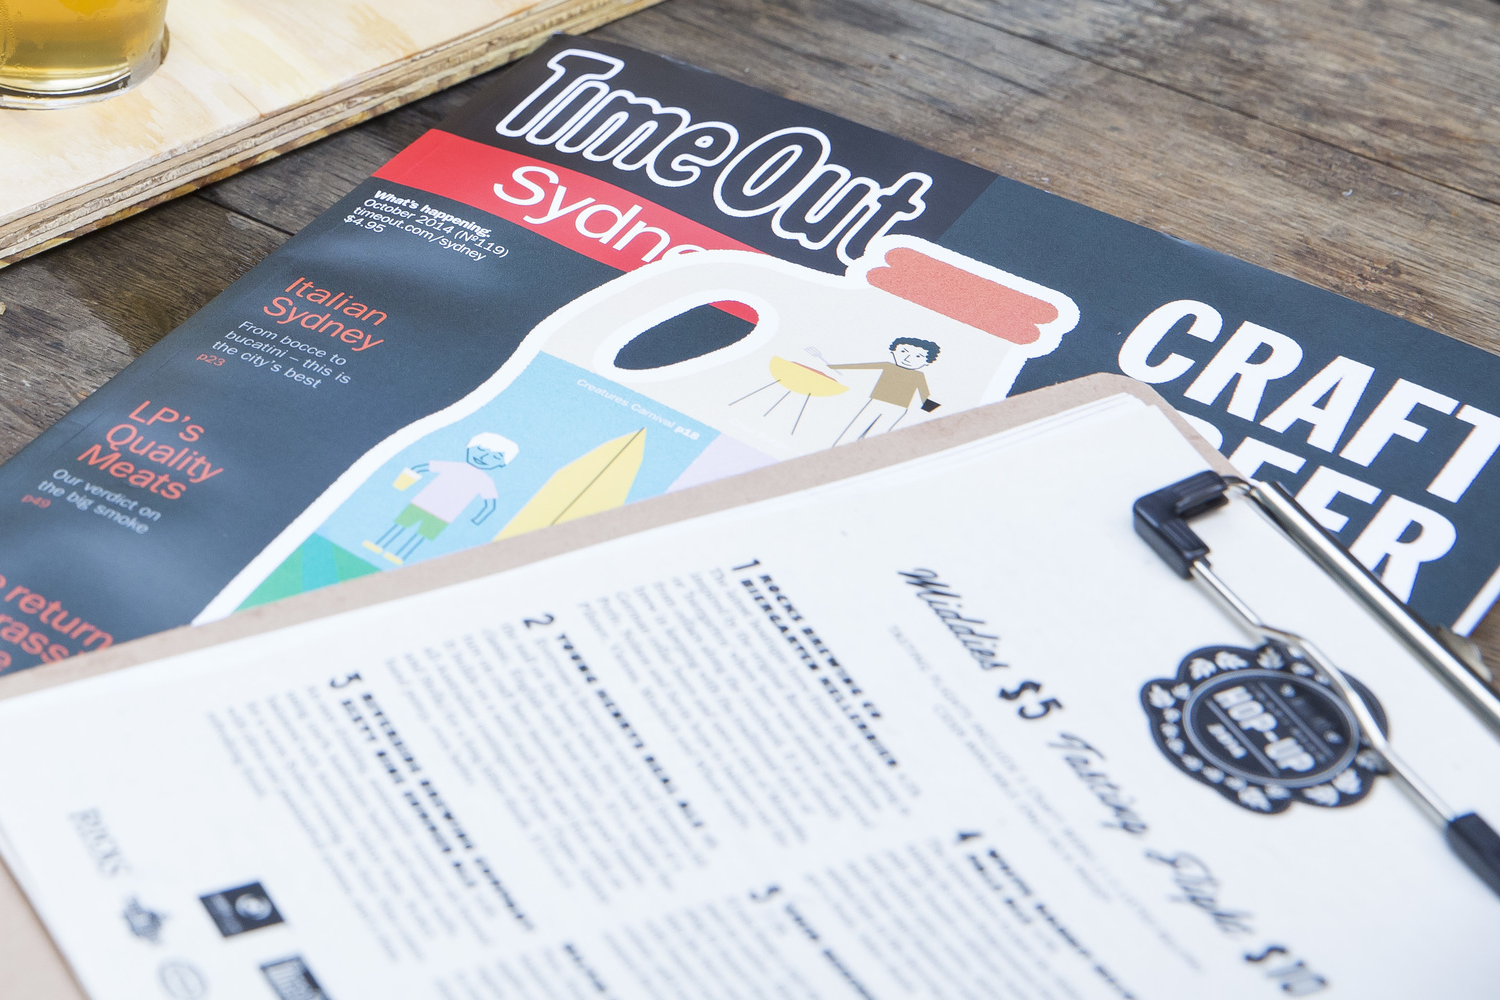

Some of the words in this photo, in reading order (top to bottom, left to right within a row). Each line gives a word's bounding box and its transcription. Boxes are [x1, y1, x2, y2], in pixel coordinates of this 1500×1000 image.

[495, 48, 739, 187] Time
[713, 126, 934, 268] Out
[344, 213, 385, 234] $4.95
[353, 206, 487, 262] timeout.com/sydney
[363, 199, 416, 223] October
[416, 213, 453, 234] 2014
[373, 190, 420, 211] What's
[420, 204, 491, 239] happening.
[493, 165, 708, 263] Sydn
[263, 297, 384, 352] Sydney
[285, 277, 388, 326] Italian
[196, 353, 226, 368] p23
[212, 340, 238, 357] the
[240, 349, 283, 374] city's
[284, 367, 322, 390] best
[224, 331, 289, 360] bucatini
[303, 358, 333, 378] this
[335, 371, 351, 386] is
[238, 321, 278, 341] From
[280, 329, 328, 360] bocce
[332, 353, 347, 367] to
[128, 400, 204, 444] LP's
[574, 378, 630, 407] Creatures
[628, 402, 676, 428] Carnival
[1119, 300, 1500, 504] CRAFT
[78, 445, 189, 500] Meats
[106, 423, 223, 485] Quality
[38, 481, 65, 497] the
[66, 491, 95, 511] big
[94, 504, 149, 534] smoke
[53, 469, 83, 486] Our
[84, 482, 139, 511] verdict
[138, 506, 161, 521] on
[4, 583, 115, 650] return
[898, 568, 1009, 671] Middies
[999, 680, 1063, 720] $5
[1213, 685, 1316, 772] HOP-UP
